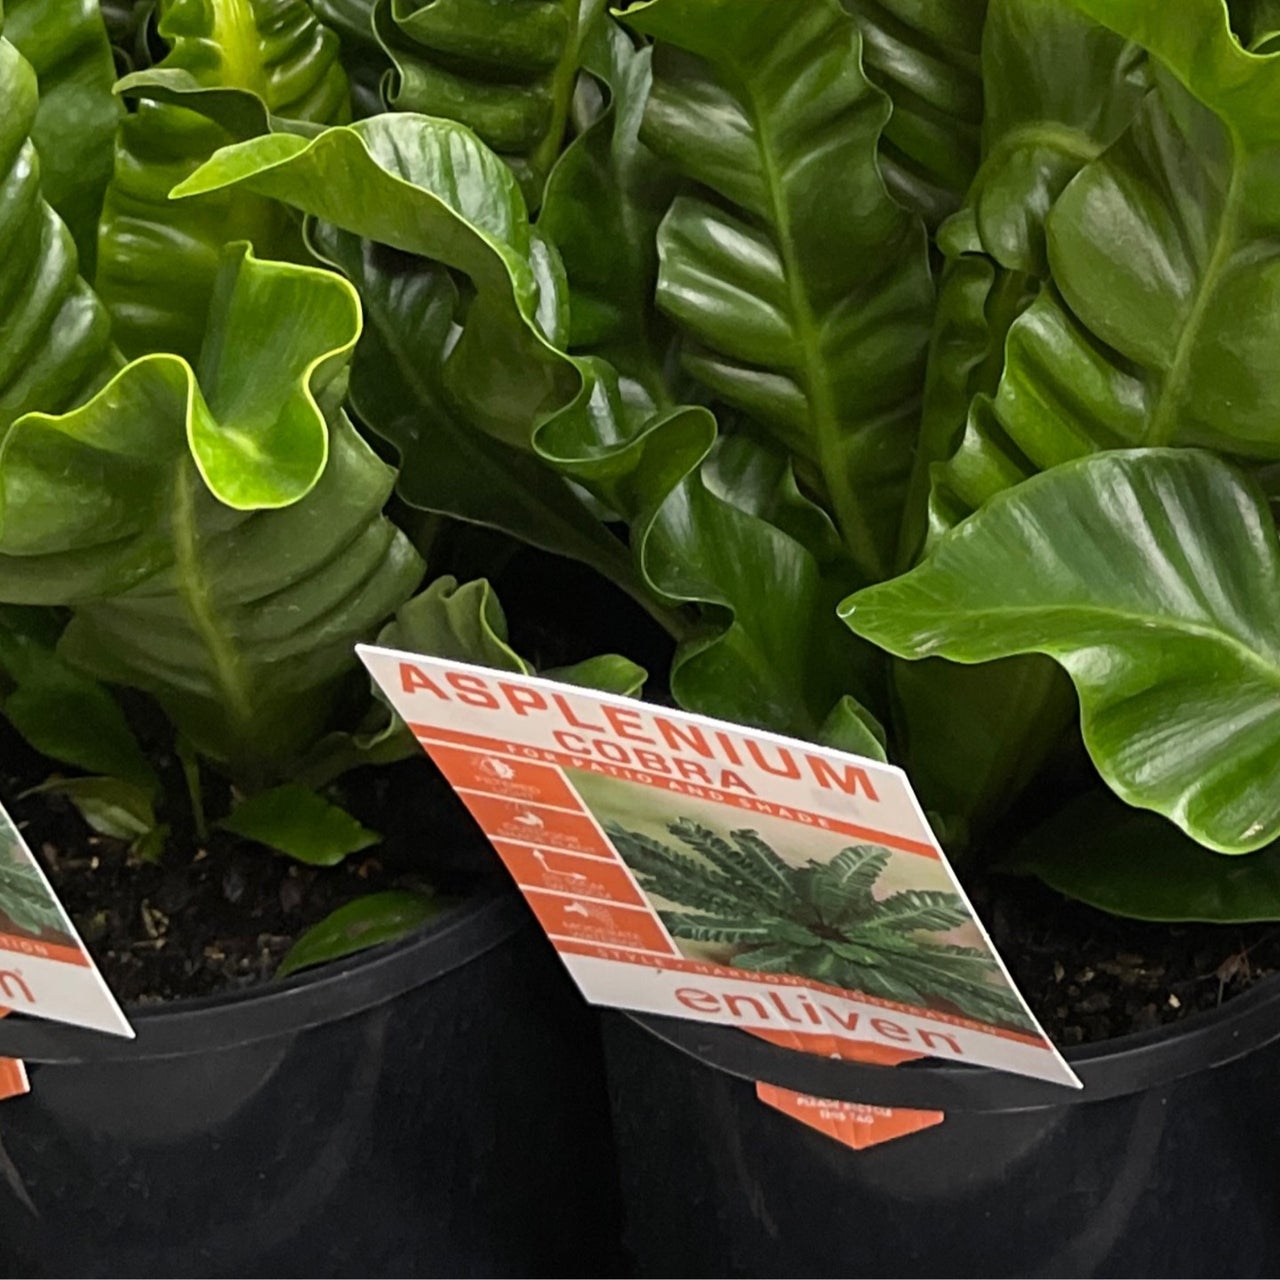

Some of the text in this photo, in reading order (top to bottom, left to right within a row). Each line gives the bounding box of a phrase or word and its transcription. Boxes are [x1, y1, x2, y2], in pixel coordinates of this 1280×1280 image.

[399, 662, 880, 803] ASPLENIUM
[552, 730, 757, 795] COBRA
[506, 743, 830, 828] FOR PATIO AND SHADE
[674, 987, 964, 1055] enliven
